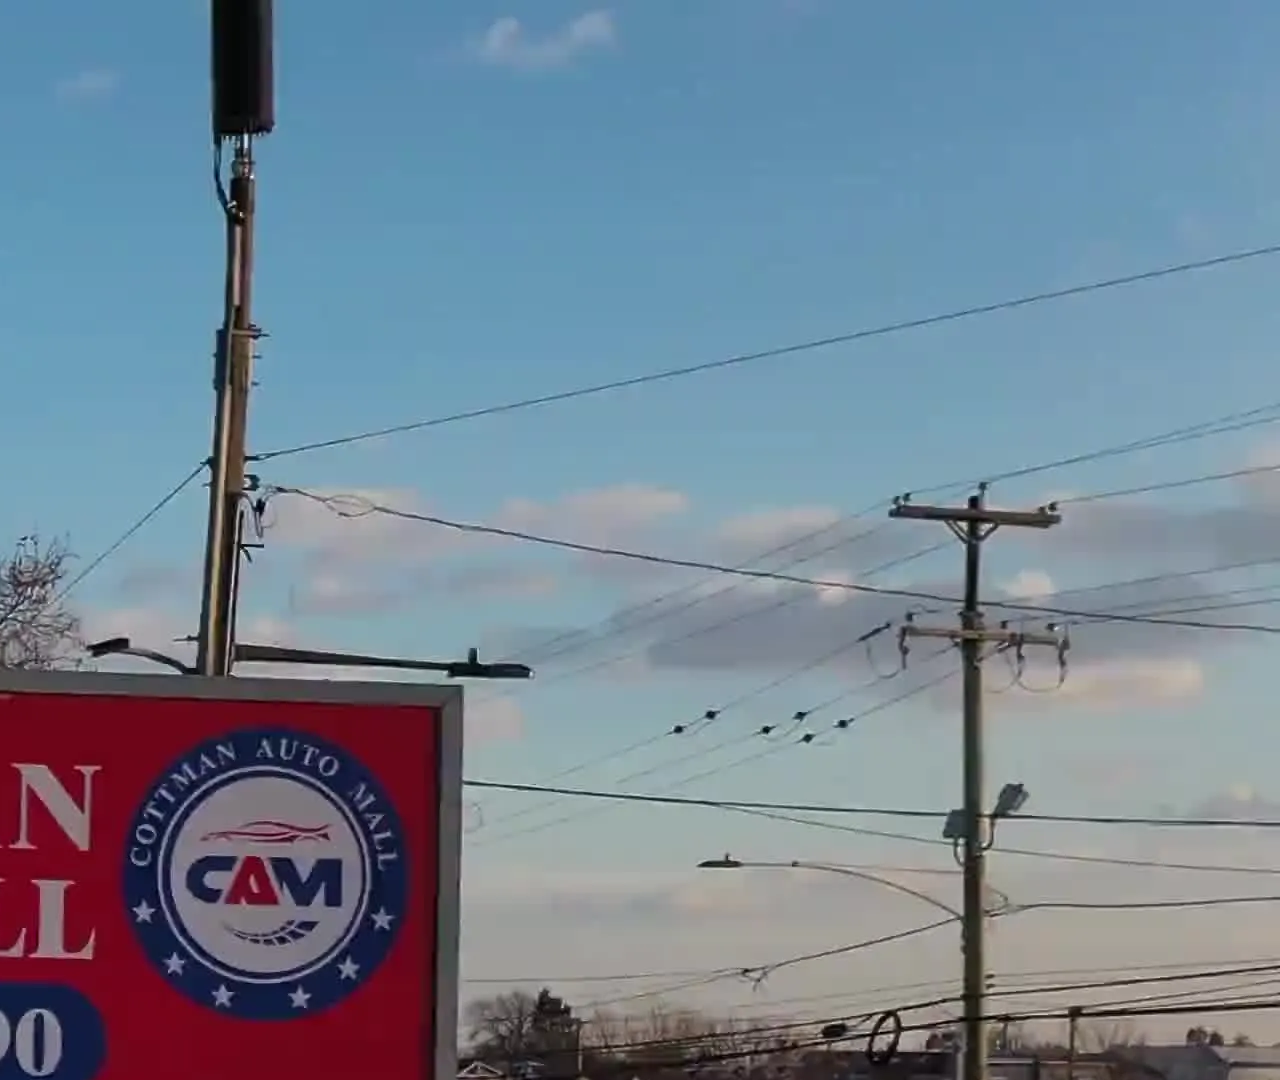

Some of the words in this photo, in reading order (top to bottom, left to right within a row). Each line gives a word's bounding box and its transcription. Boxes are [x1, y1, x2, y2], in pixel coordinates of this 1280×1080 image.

[130, 741, 238, 867] COTTMAN
[256, 737, 340, 778] AUTO
[348, 781, 398, 872] MALL
[185, 855, 343, 907] CAM
